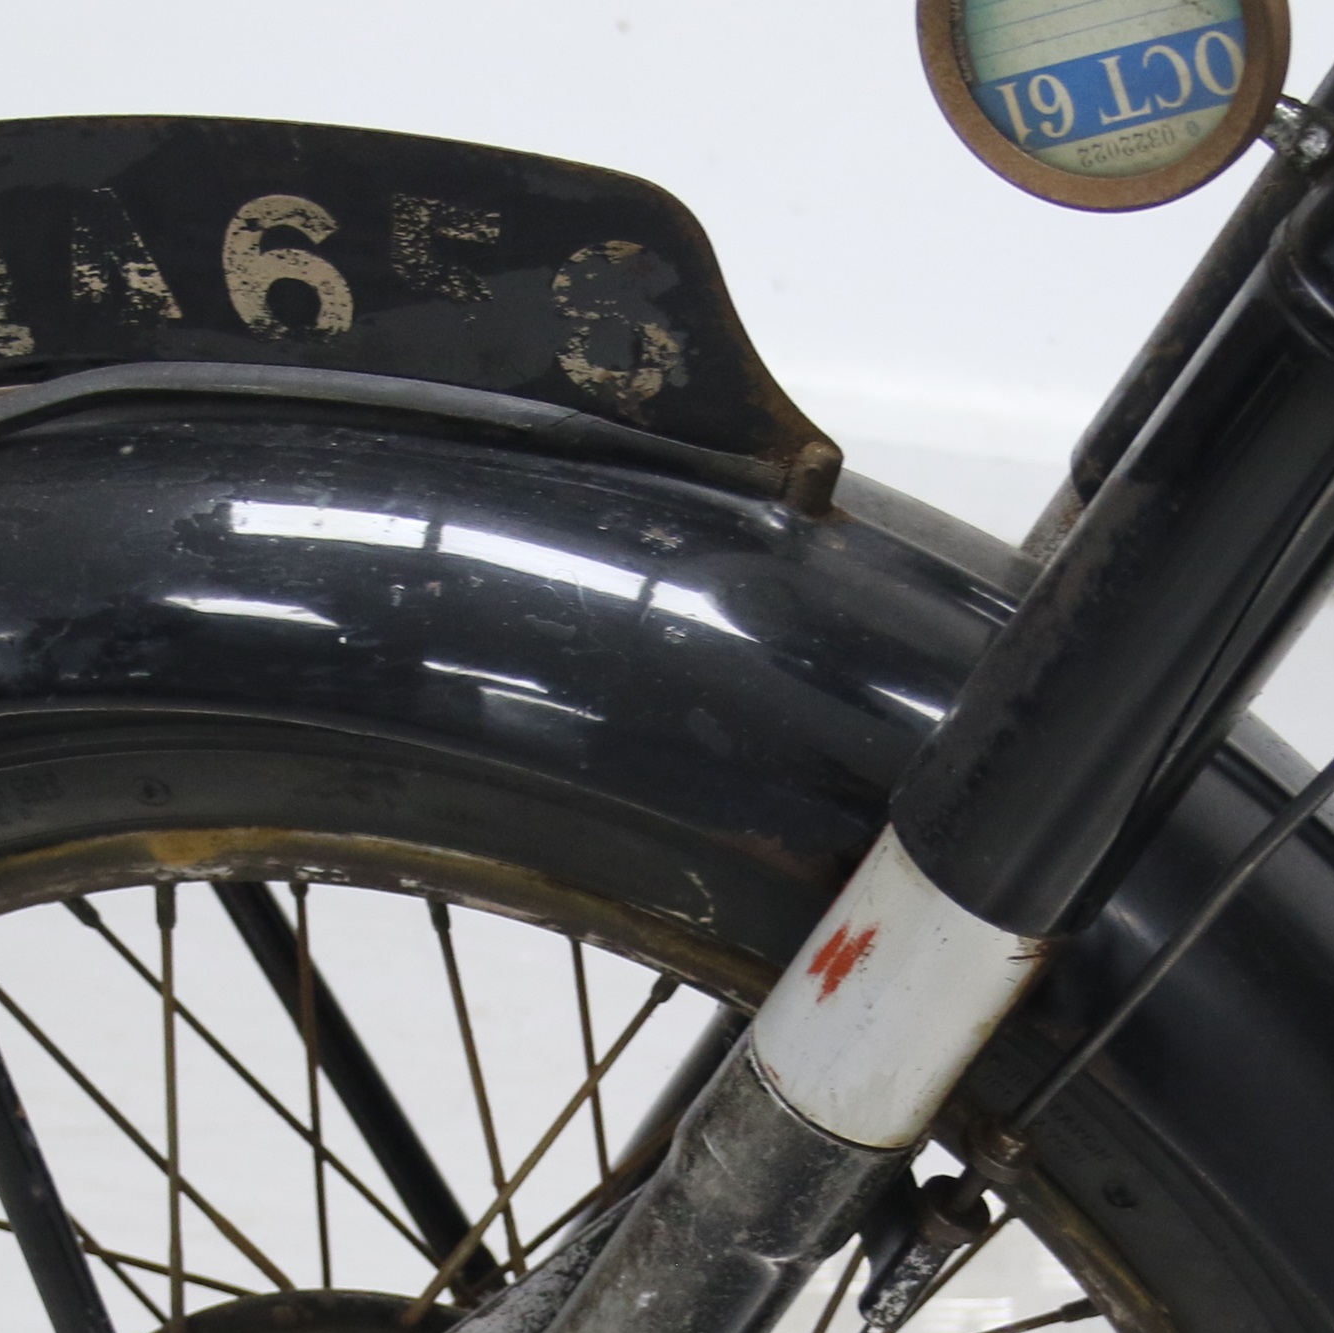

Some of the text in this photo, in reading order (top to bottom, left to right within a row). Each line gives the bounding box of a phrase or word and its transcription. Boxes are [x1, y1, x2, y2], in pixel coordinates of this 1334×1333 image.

[995, 31, 1245, 144] OCT 61
[1078, 124, 1176, 168] 0322022
